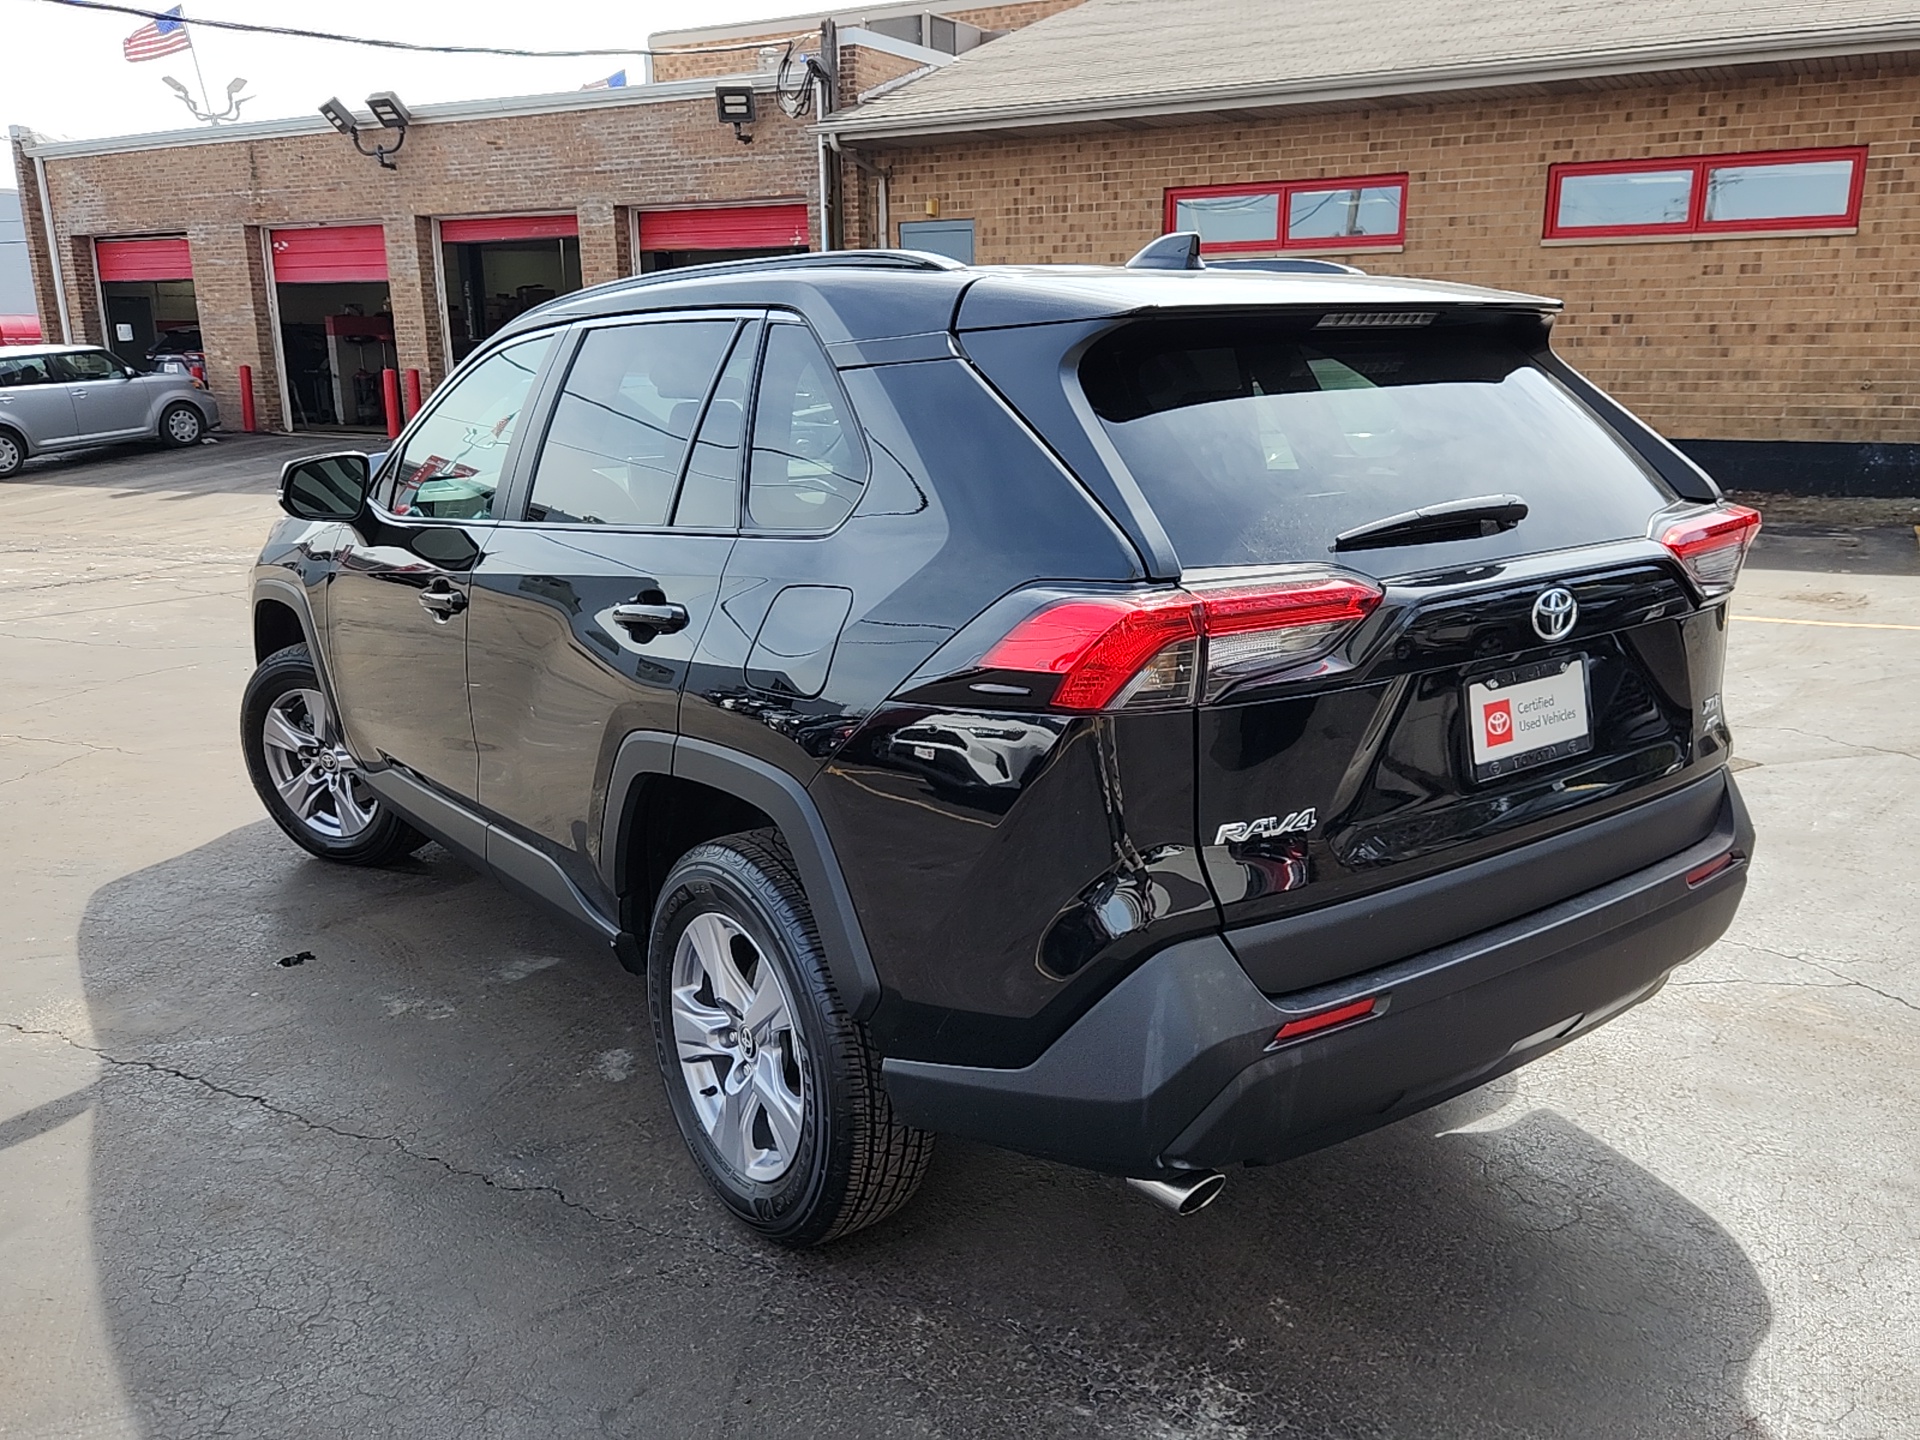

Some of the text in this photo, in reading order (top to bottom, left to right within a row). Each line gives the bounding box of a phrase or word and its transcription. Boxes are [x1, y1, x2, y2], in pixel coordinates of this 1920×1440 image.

[1517, 694, 1555, 714] Certified
[1518, 708, 1576, 731] Used Vehicles
[1512, 745, 1557, 769] TOYOTA
[1213, 806, 1318, 846] RAV4
